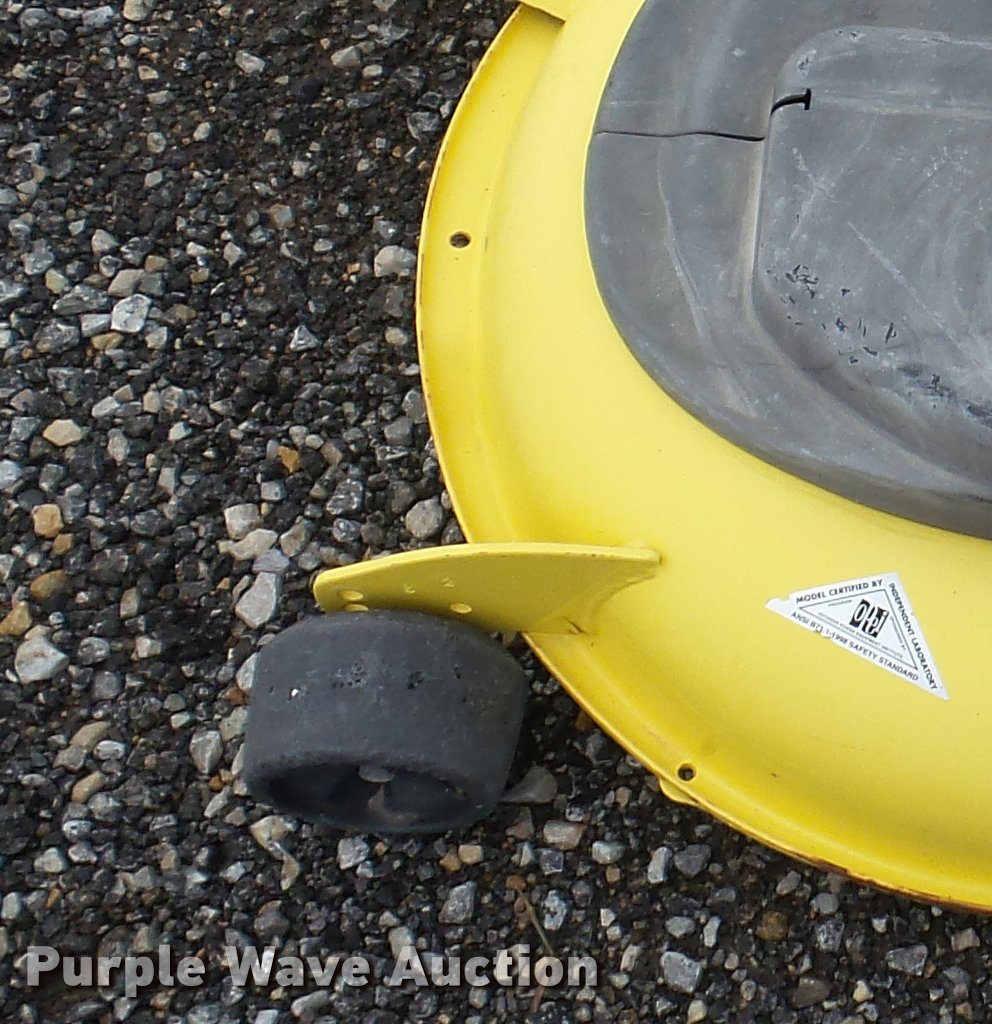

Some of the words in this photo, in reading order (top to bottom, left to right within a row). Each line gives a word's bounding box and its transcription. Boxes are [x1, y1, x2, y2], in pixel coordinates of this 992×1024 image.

[795, 591, 826, 604] MODEL
[828, 581, 869, 597] CERTIFIED
[872, 579, 883, 587] BY
[791, 611, 809, 624] ANSI
[848, 640, 878, 660] SAFETY
[879, 656, 919, 681] STANDARD
[888, 582, 915, 636] INDEPENDENT
[911, 635, 938, 690] LABORATORY
